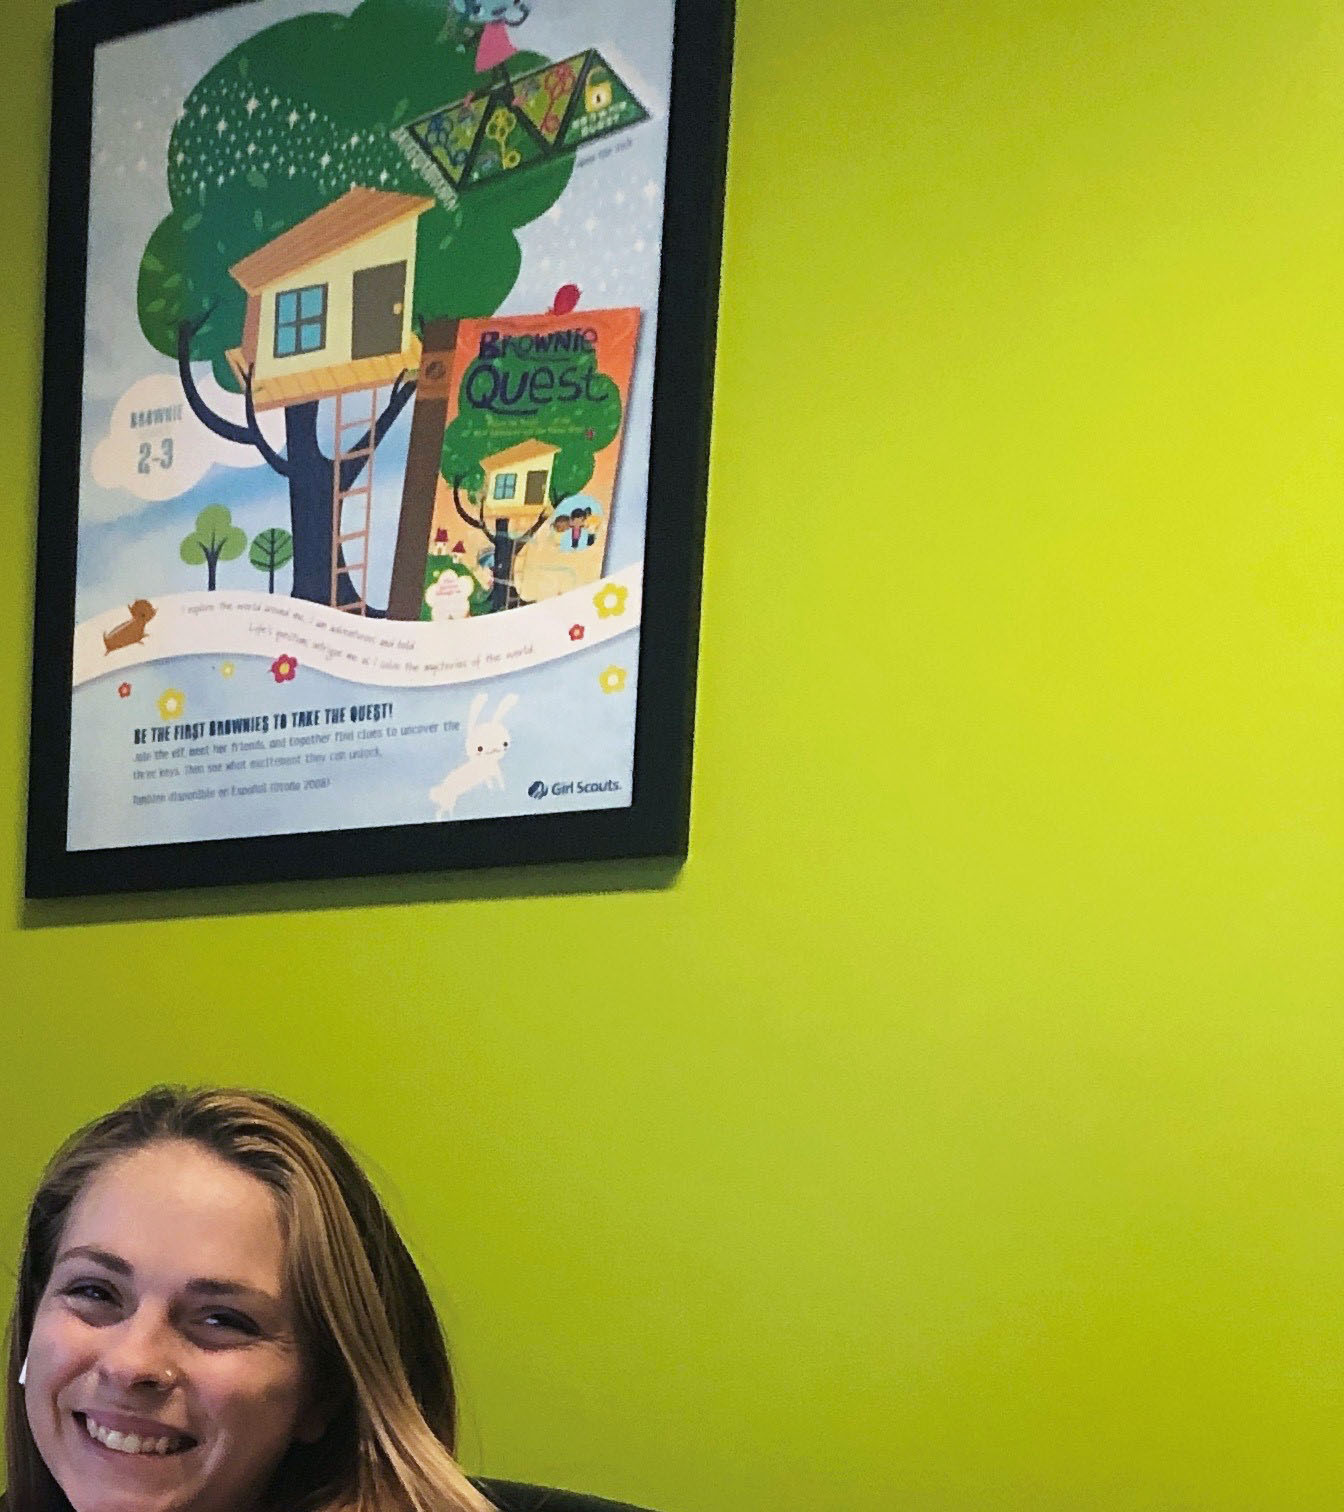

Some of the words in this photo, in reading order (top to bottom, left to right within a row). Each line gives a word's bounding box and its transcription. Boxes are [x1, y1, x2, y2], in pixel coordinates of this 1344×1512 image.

[466, 364, 609, 415] Quest
[138, 438, 174, 474] 2-3
[133, 728, 148, 745] BE
[151, 725, 171, 743] THE
[174, 722, 206, 741] FIRST
[209, 715, 270, 736] BROWNIES
[273, 713, 288, 730] TO
[292, 710, 321, 728] TAKE
[324, 707, 347, 725] THE
[350, 702, 394, 723] QUEST!
[154, 748, 170, 761] the
[213, 744, 228, 754] her
[269, 737, 287, 749] and
[289, 734, 332, 748] together
[334, 731, 354, 743] find
[357, 728, 383, 741] clues
[386, 726, 398, 738] to
[400, 723, 439, 736] uncover
[443, 720, 461, 732] the
[552, 781, 574, 796] Girl
